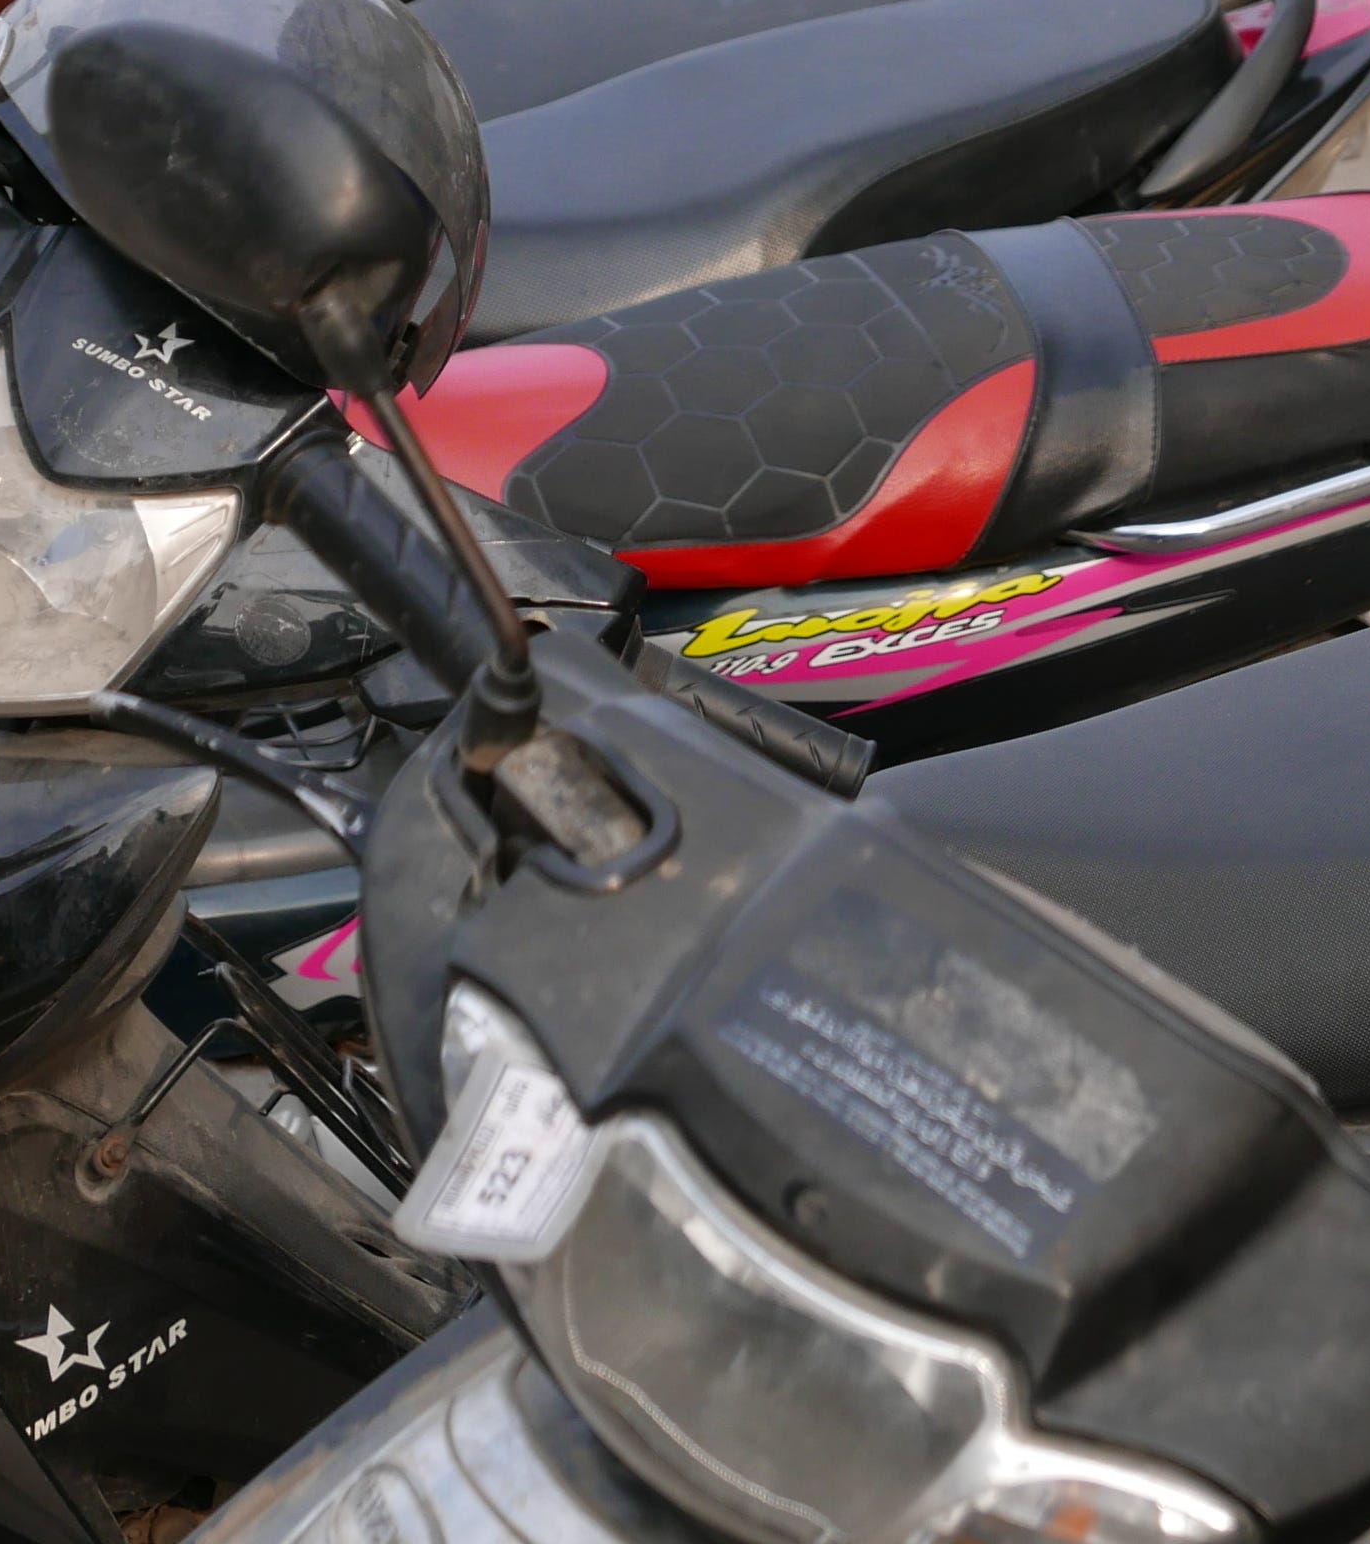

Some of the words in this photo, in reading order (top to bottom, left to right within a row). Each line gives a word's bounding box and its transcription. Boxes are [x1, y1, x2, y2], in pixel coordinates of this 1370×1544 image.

[71, 337, 146, 379] SUMBO
[148, 377, 213, 422] STAR
[808, 608, 1007, 669] EXCES
[25, 1383, 99, 1442] MBO
[108, 1317, 188, 1391] STAR
